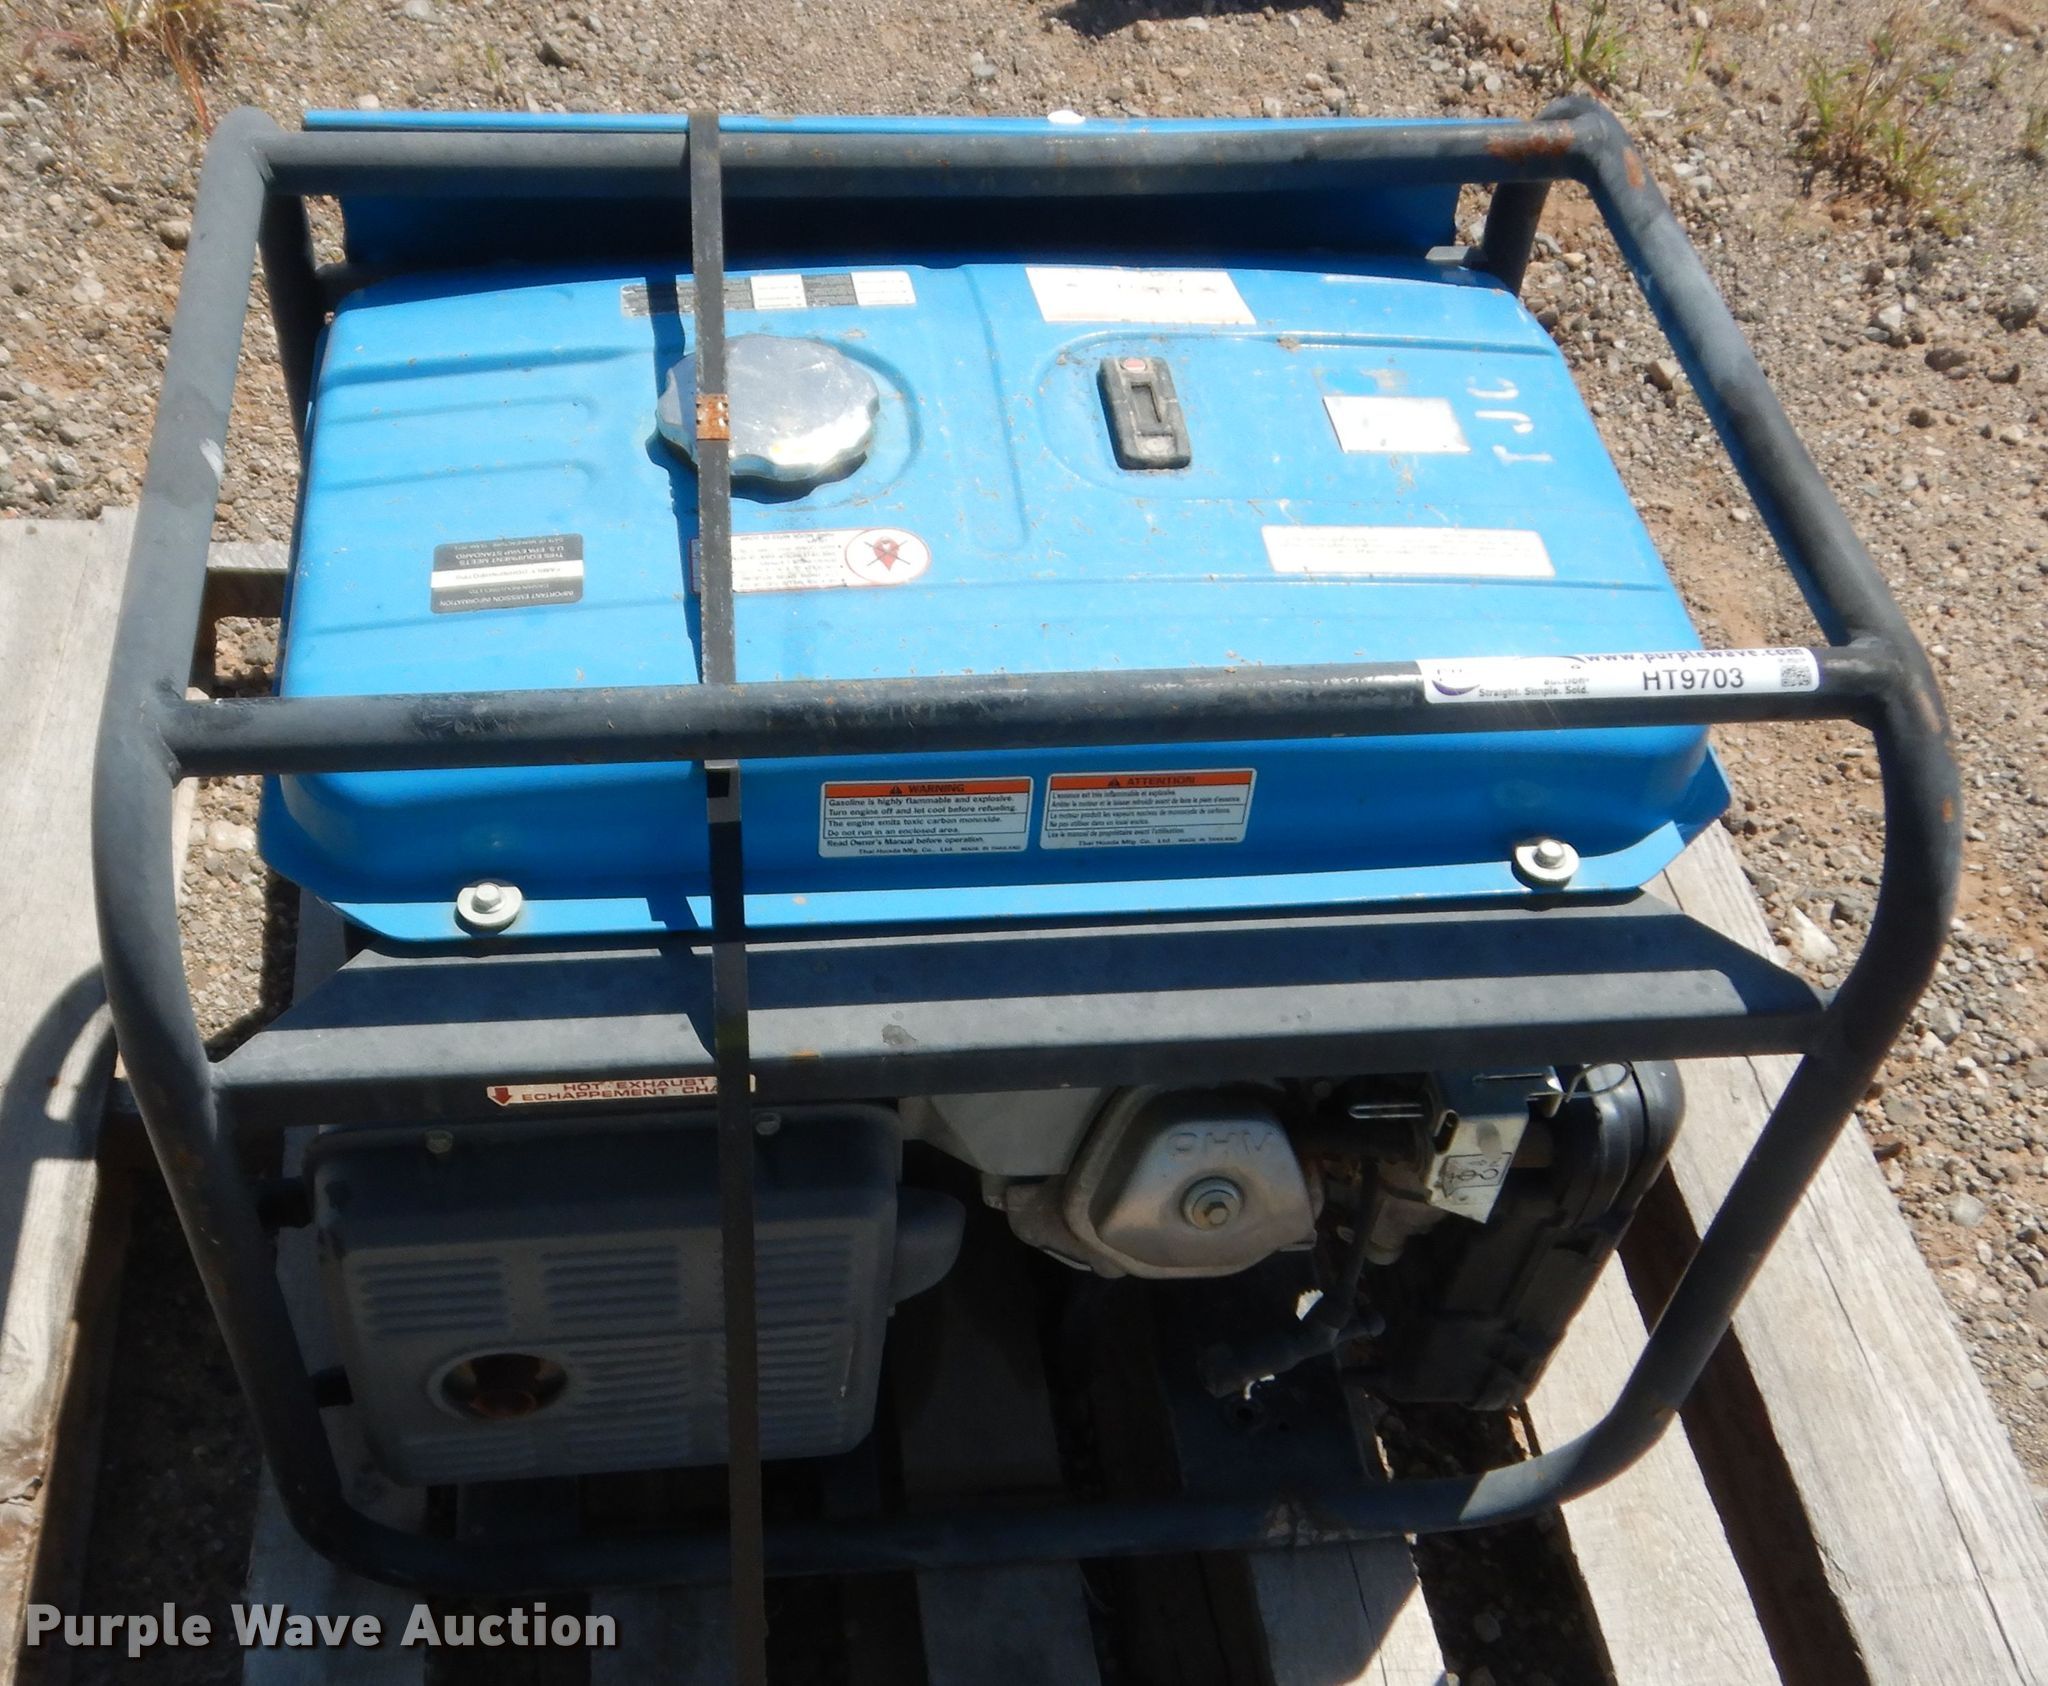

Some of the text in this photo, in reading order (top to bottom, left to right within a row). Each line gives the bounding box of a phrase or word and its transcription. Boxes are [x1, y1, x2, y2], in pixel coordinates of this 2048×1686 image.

[456, 550, 502, 560] STANDARD
[491, 554, 543, 563] EQUIPMENT
[439, 590, 575, 607] IMPORTANT EMISSION INFORMATION
[1643, 667, 1745, 691] HT9703
[1565, 685, 1590, 695] Sold.
[1127, 776, 1196, 786] ATTENTION
[908, 784, 965, 794] WARNING
[829, 798, 865, 806] Gasoline
[868, 798, 875, 806] is
[878, 798, 902, 807] highly
[906, 796, 952, 806] flammable
[972, 795, 1013, 804] explosive.
[850, 809, 878, 818] engine
[927, 806, 946, 814] cool
[978, 804, 1017, 813] refueling.
[829, 820, 844, 828] The
[846, 820, 875, 828] engine
[926, 817, 957, 825] carbon
[959, 816, 1002, 824] monoxide.
[827, 829, 839, 837] Do
[898, 827, 936, 835] enclosed
[916, 837, 943, 845] before
[944, 836, 984, 845] operation.
[563, 1078, 707, 1093] HOT EXHAUST
[522, 1085, 718, 1102] ECHAPPEMENT CHA
